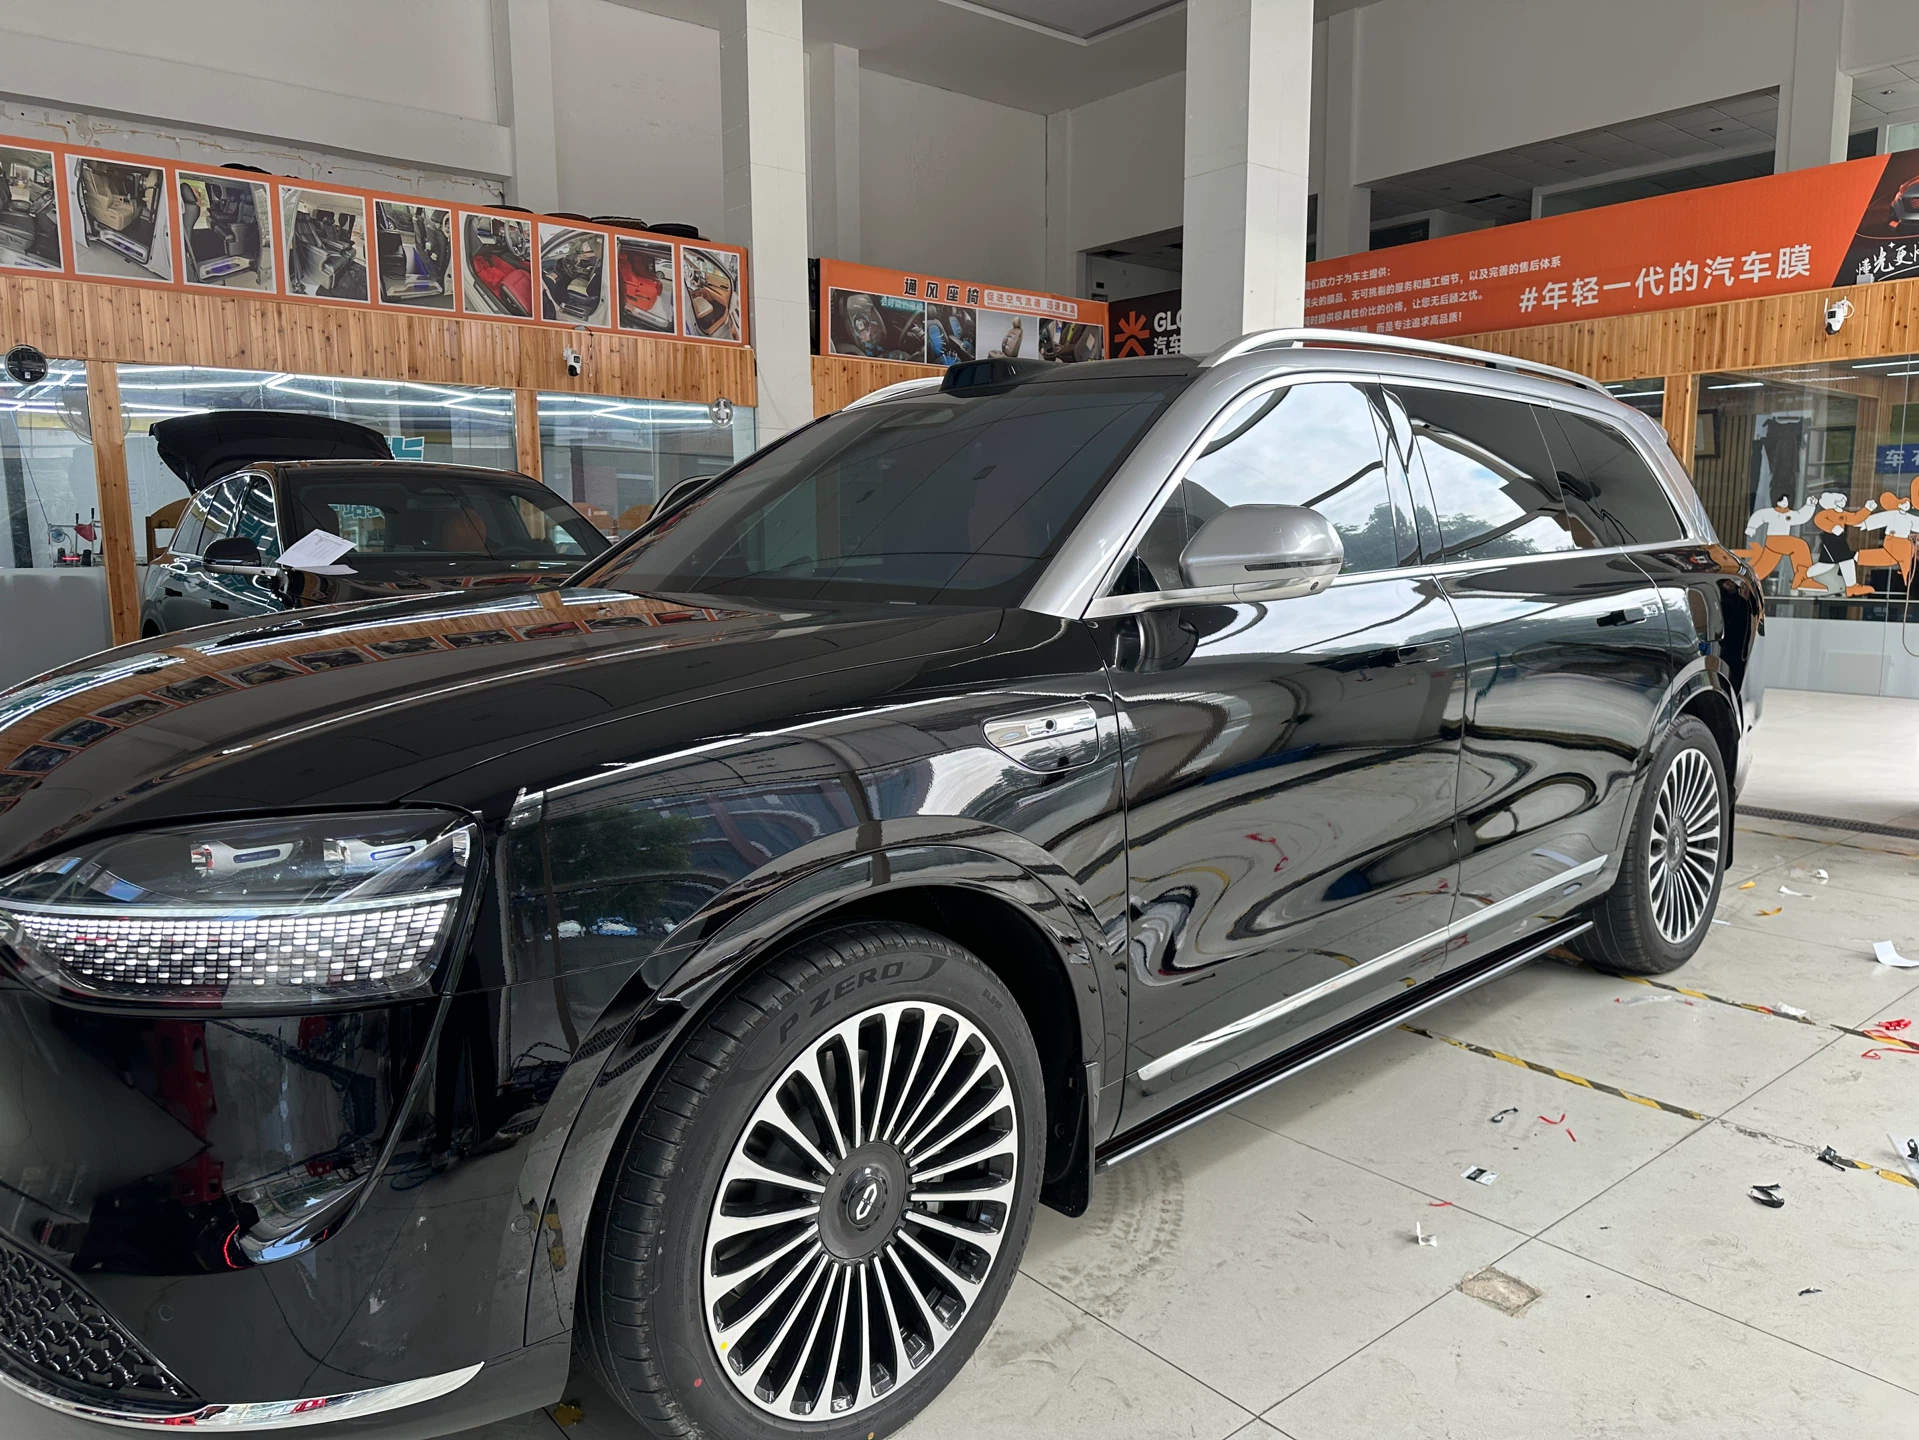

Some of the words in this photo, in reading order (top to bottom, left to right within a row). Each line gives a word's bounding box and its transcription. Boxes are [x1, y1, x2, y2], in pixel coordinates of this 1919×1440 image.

[904, 277, 979, 305] 通风座椅
[1519, 244, 1811, 313] #年轻一代的汽车膜
[779, 1012, 799, 1045] P
[809, 961, 904, 1018] ZERO
